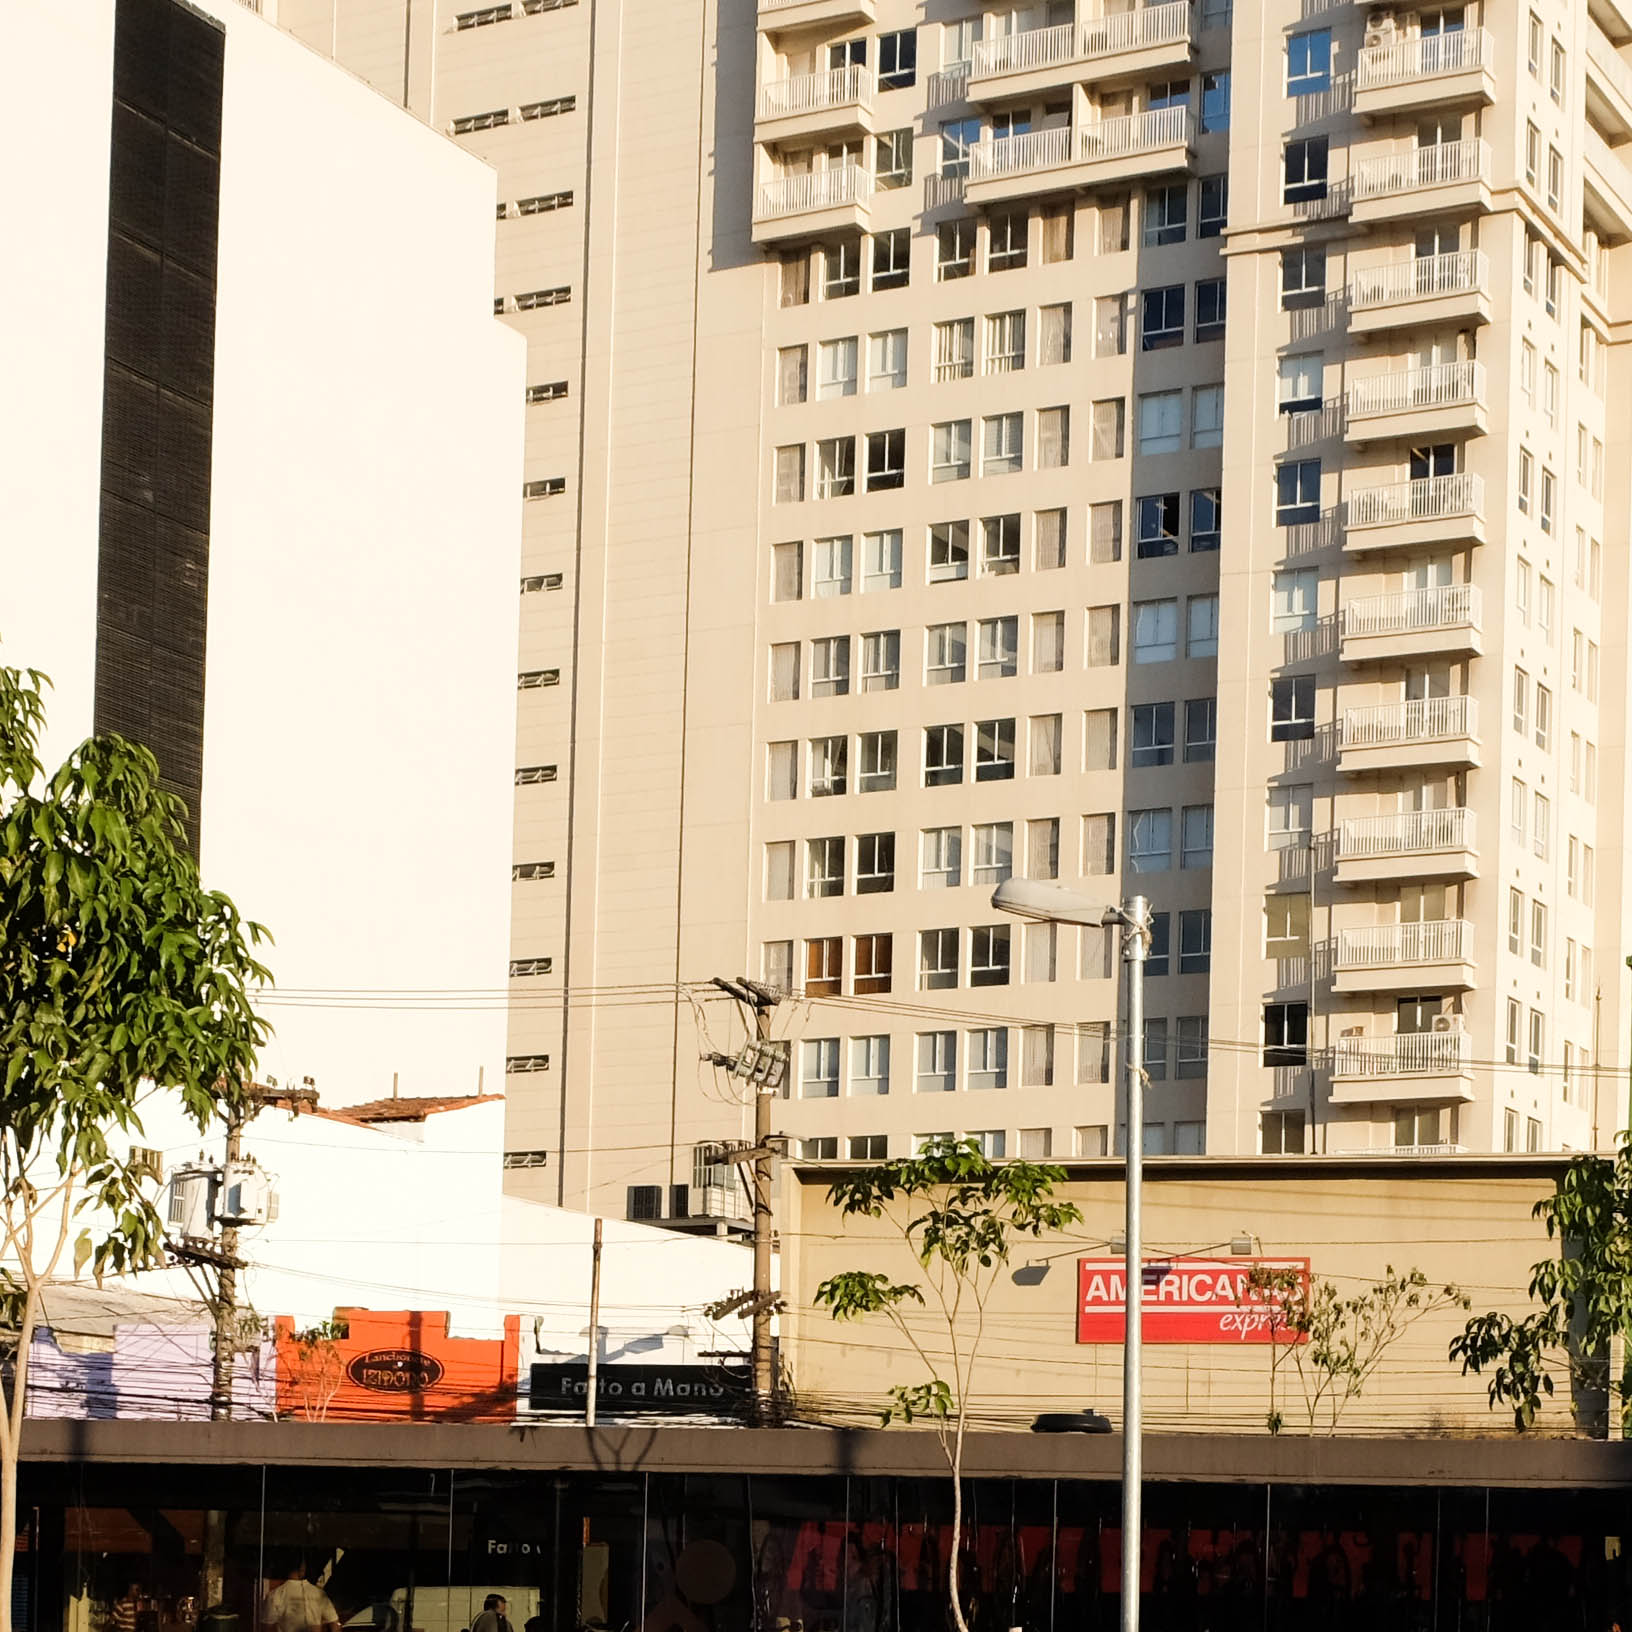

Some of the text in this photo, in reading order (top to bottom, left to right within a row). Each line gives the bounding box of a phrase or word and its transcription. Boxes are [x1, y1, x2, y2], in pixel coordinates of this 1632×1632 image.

[1219, 1312, 1296, 1340] expr
[560, 1377, 724, 1397] Fato a Mano
